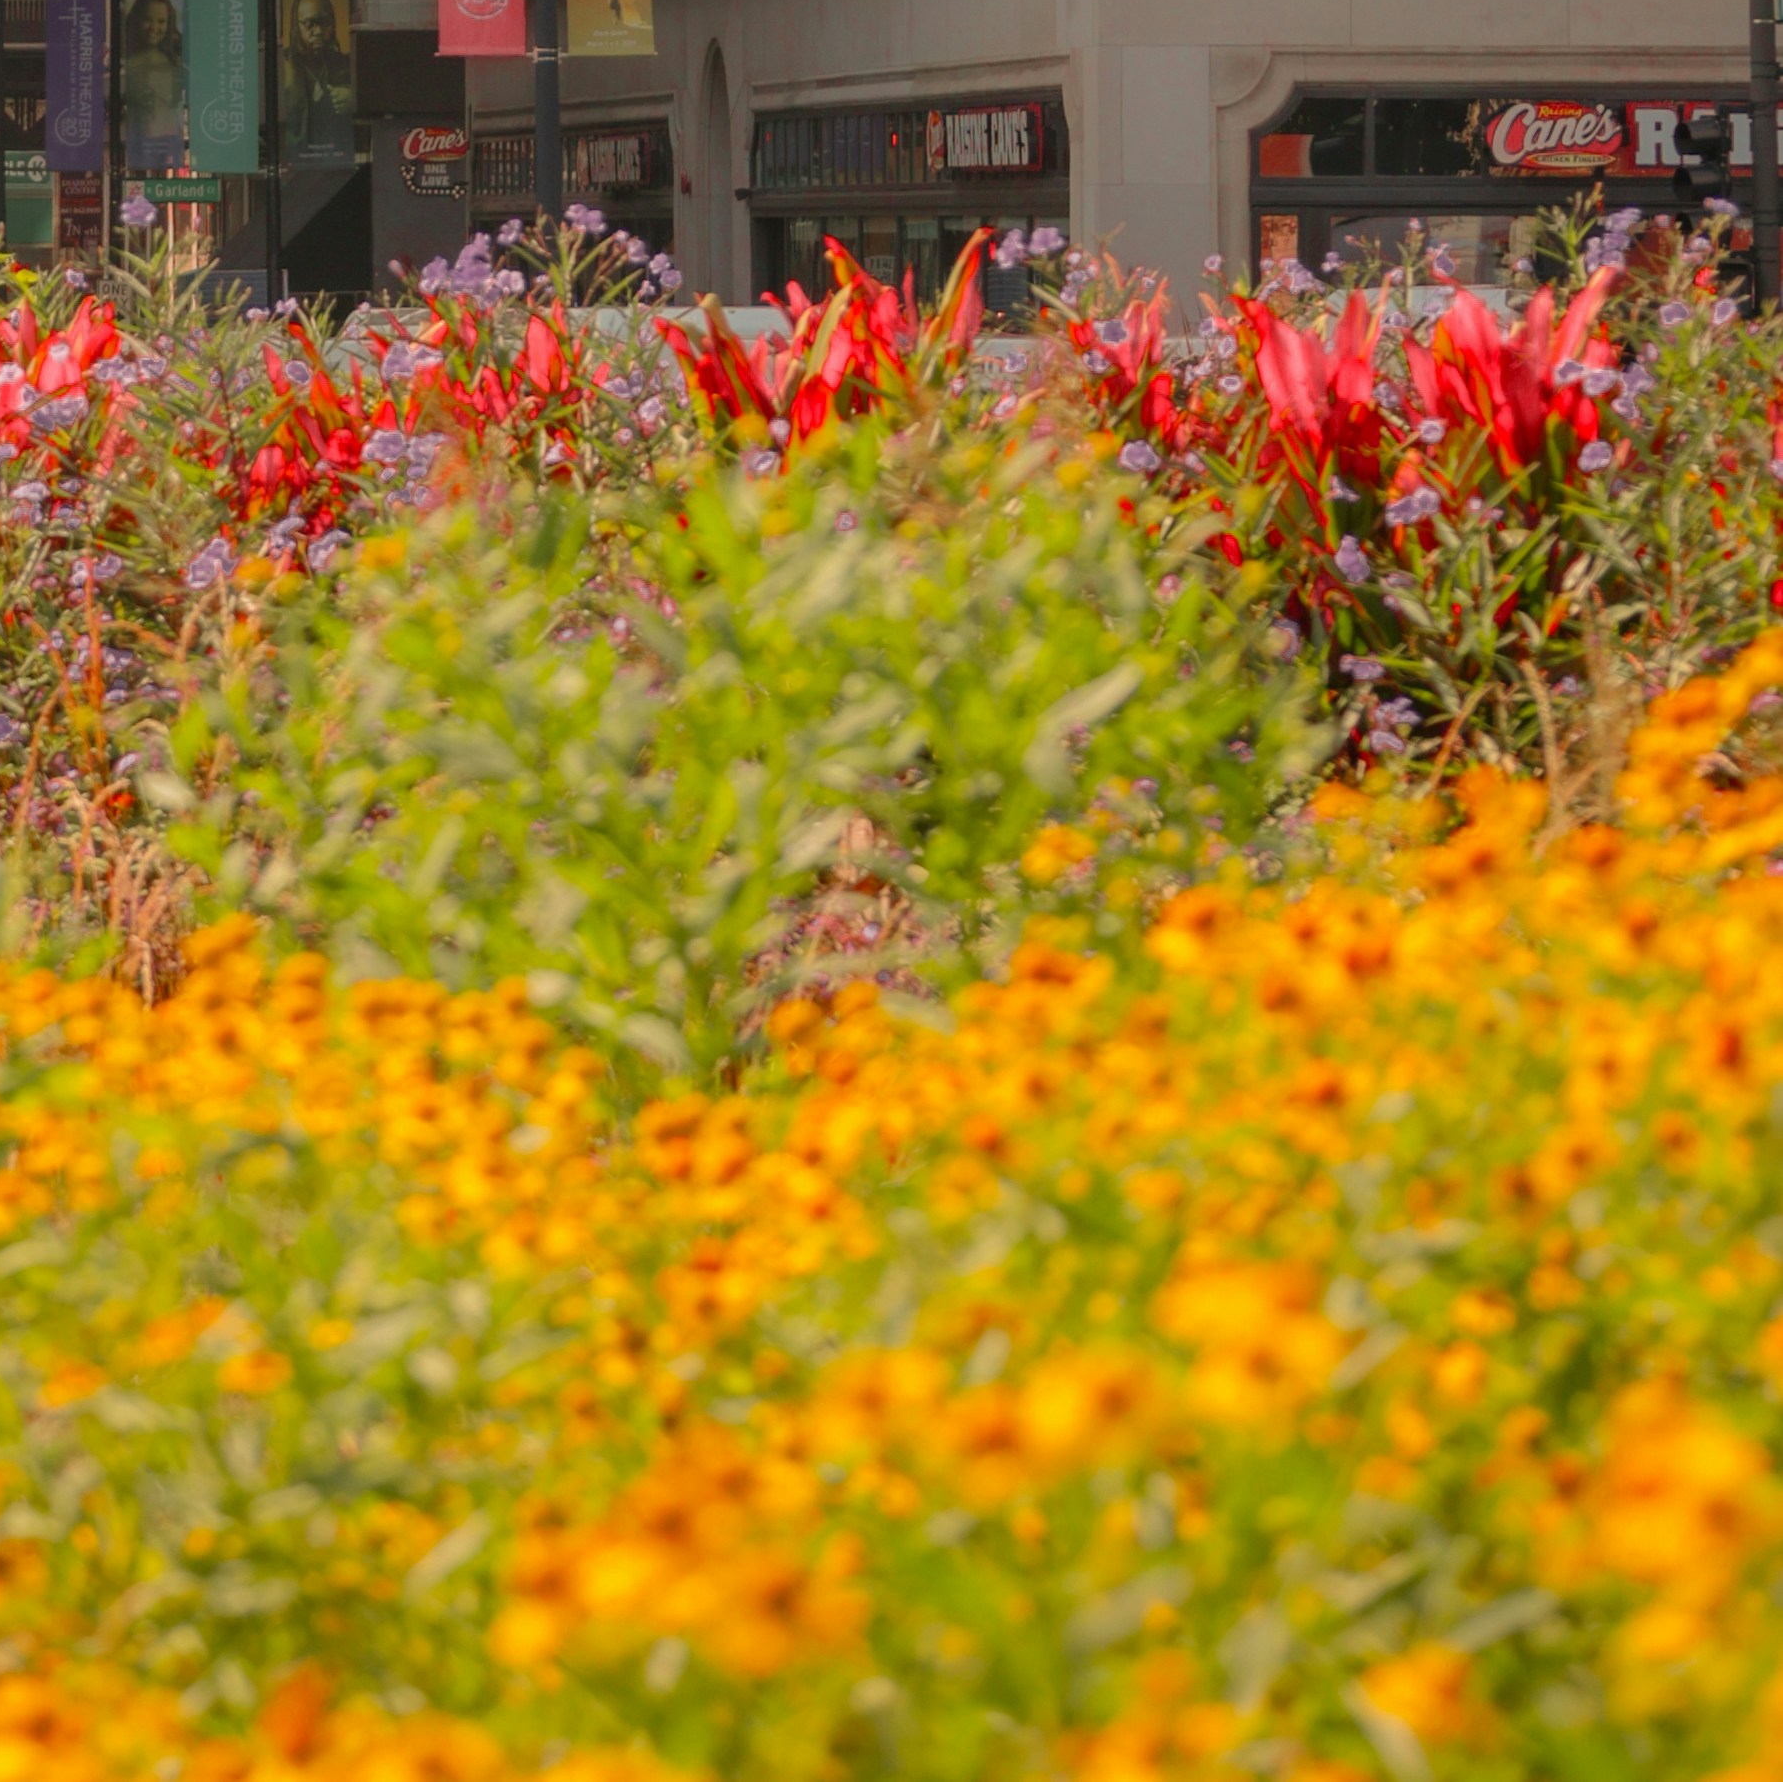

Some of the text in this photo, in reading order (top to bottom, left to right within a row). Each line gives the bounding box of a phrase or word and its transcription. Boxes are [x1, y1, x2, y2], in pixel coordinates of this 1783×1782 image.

[79, 13, 92, 139] HARRIS THEATER
[229, 57, 245, 135] THEATER
[214, 108, 227, 131] 20
[1538, 105, 1583, 119] Raising
[66, 117, 77, 136] 20
[1491, 103, 1623, 165] Cane's
[403, 128, 468, 160] Cane's
[946, 109, 1029, 167] RAISING CANE'S
[424, 164, 447, 174] ONE
[155, 183, 204, 197] Garland
[421, 176, 450, 185] LOVE
[103, 283, 128, 295] ONE
